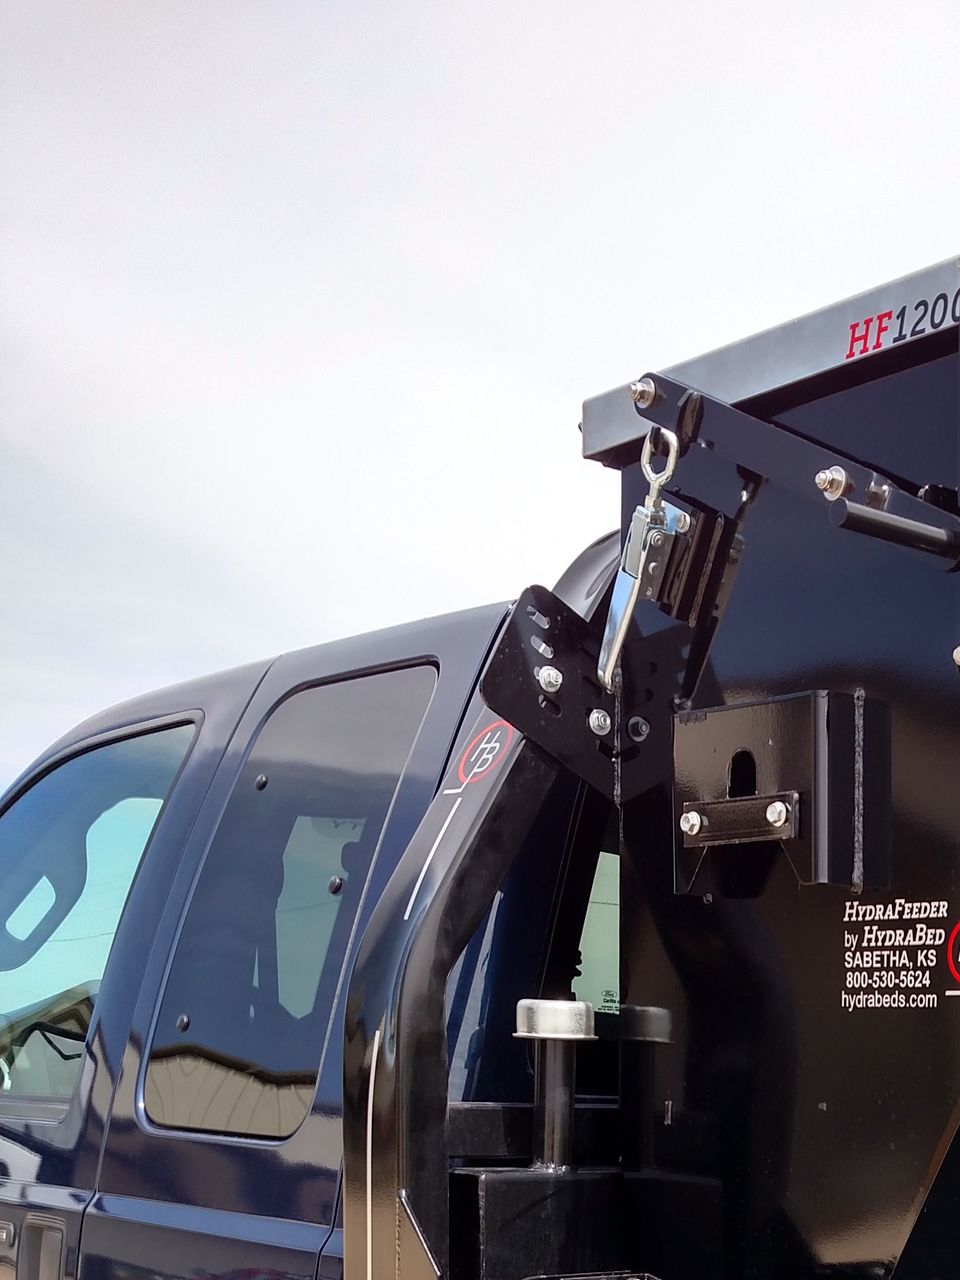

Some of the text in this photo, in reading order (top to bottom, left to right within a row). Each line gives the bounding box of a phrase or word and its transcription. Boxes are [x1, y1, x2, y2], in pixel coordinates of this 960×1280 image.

[843, 899, 948, 922] HYDRAFEEDER
[844, 924, 945, 950] by HYDRABED
[844, 949, 937, 970] SABETHA, KS
[846, 970, 930, 988] 800-530-5624
[841, 990, 938, 1012] hydrabeds.com
